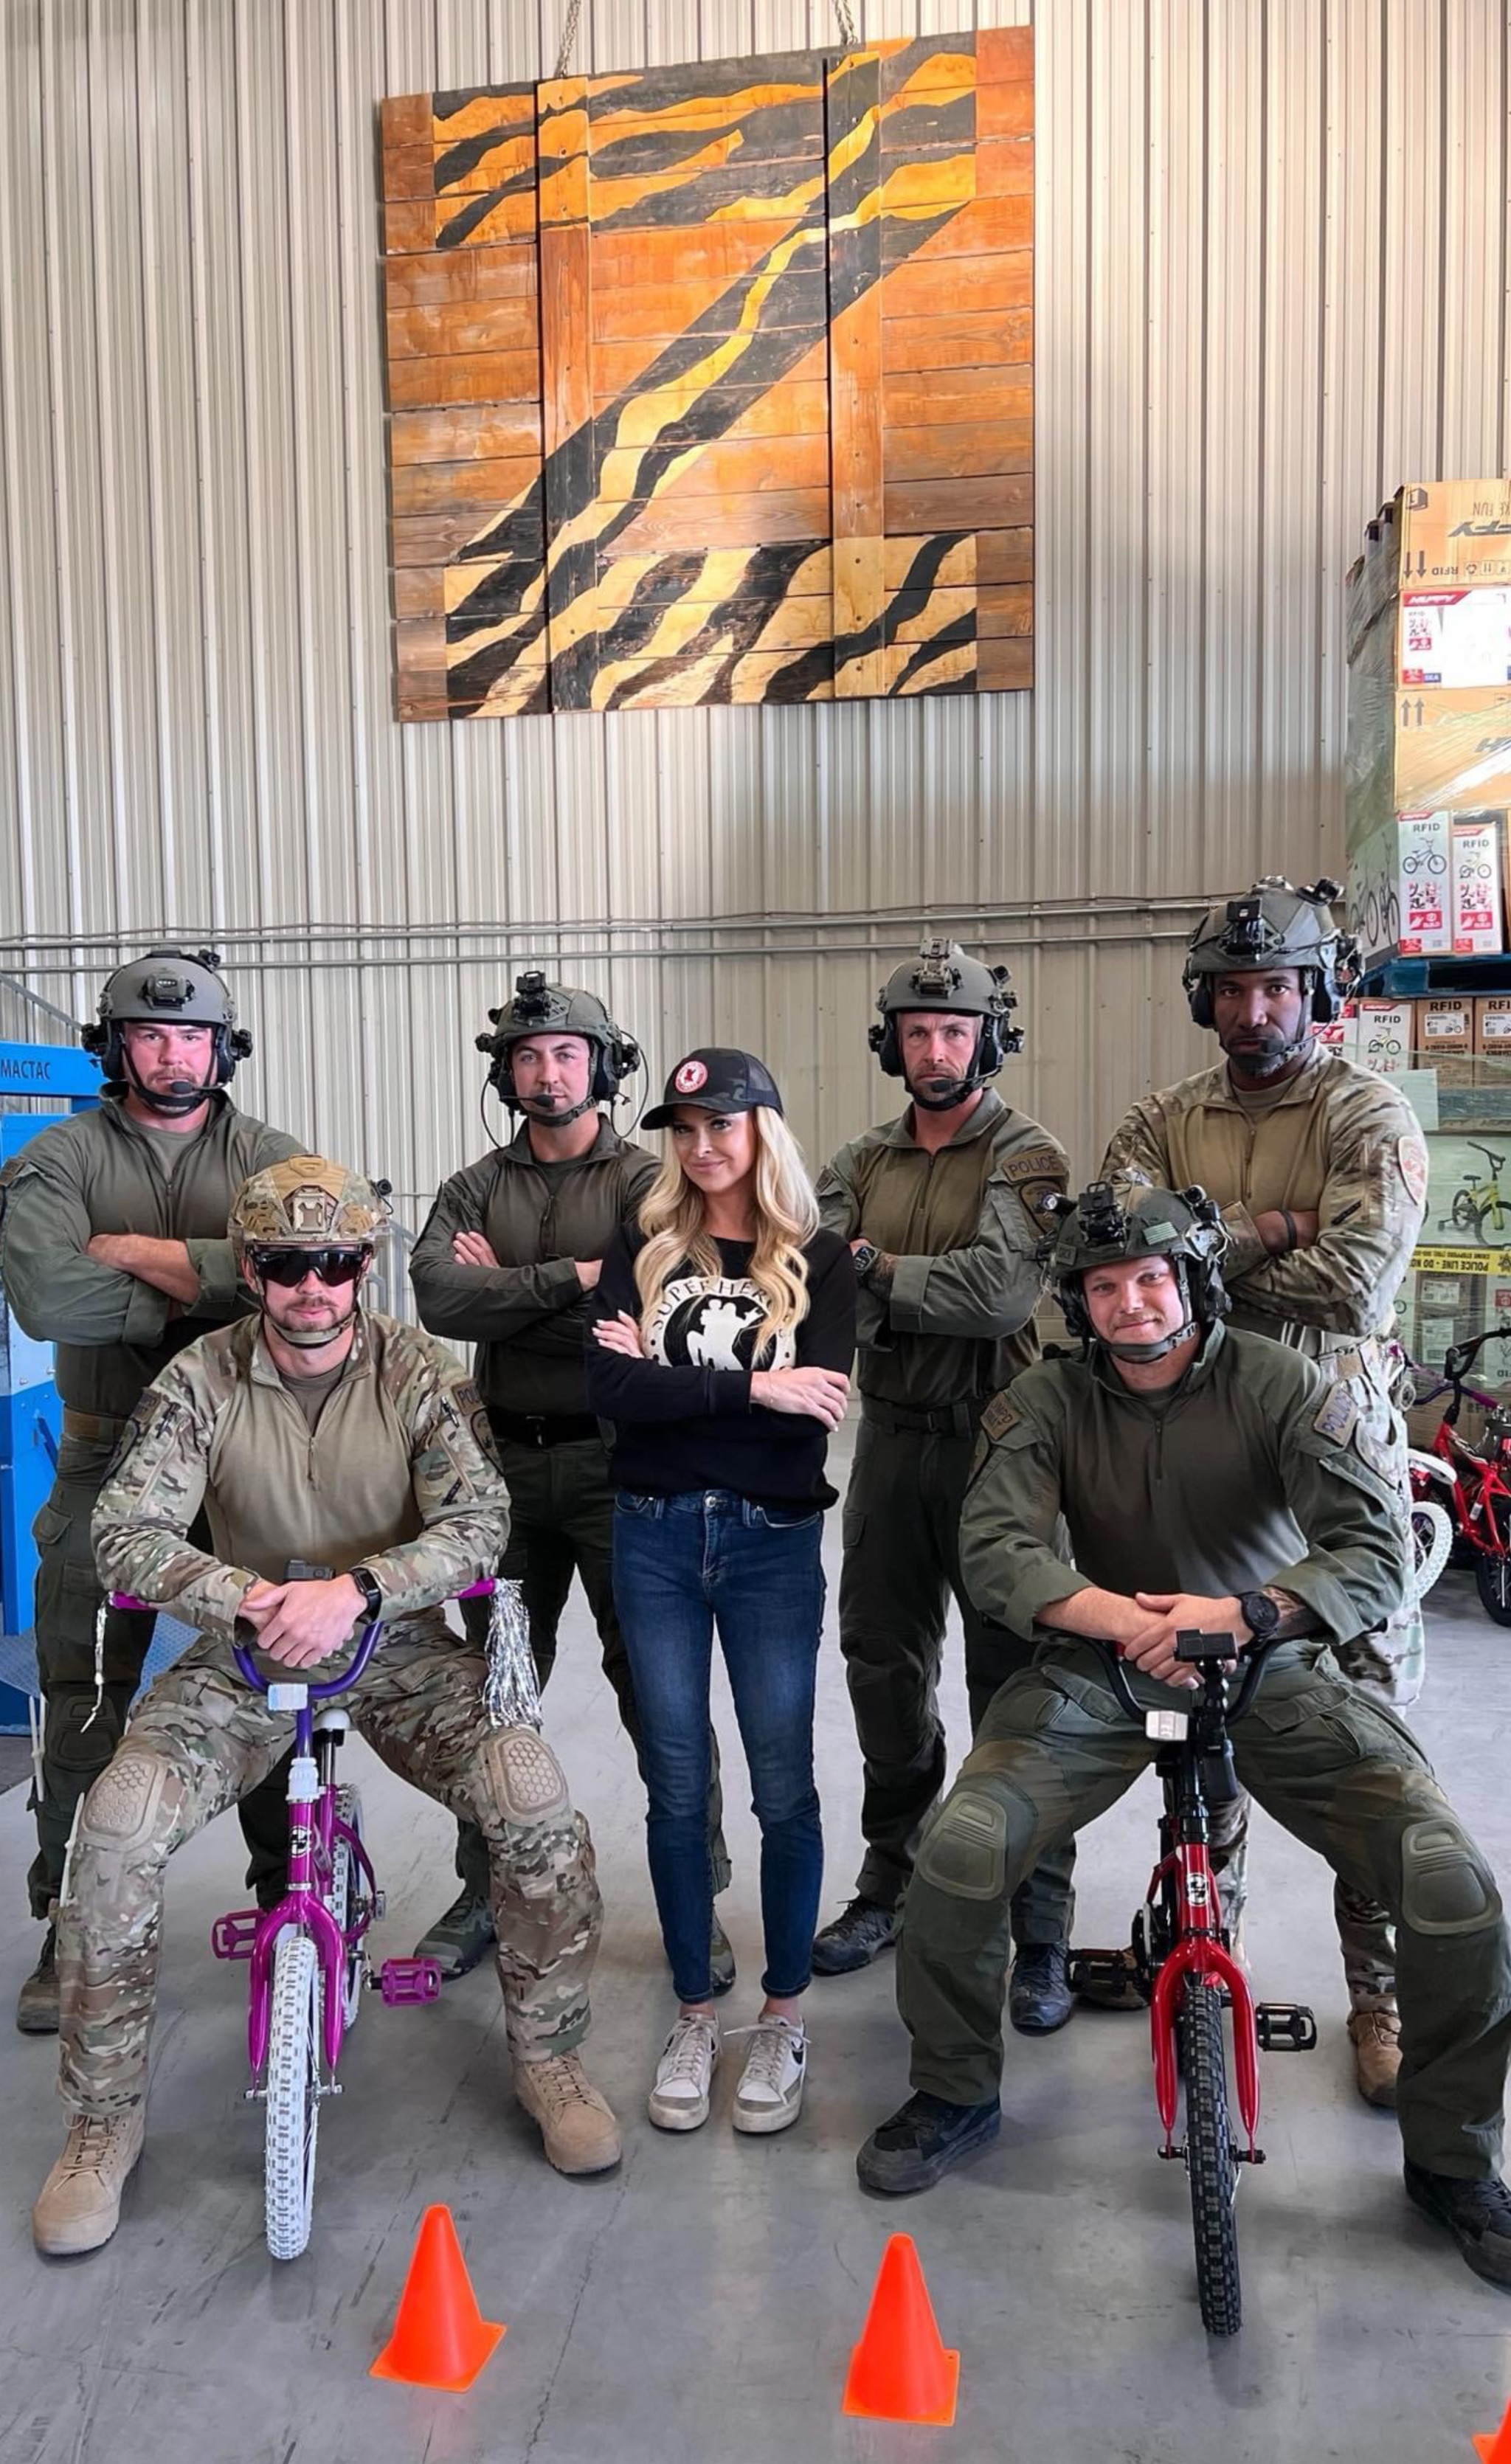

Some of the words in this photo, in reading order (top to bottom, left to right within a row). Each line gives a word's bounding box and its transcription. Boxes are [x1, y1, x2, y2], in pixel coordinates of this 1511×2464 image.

[1431, 566, 1459, 575] RFID
[1413, 823, 1440, 832] RFID
[1462, 839, 1490, 848] RFID
[1430, 1000, 1462, 1011] RFID
[1374, 1014, 1401, 1023] RFID
[1, 1059, 51, 1080] MACTAC
[1008, 1155, 1059, 1177] POLICE
[1423, 1259, 1434, 1268] DO
[1442, 1259, 1458, 1270] LINE
[1461, 1260, 1488, 1271] POLICE
